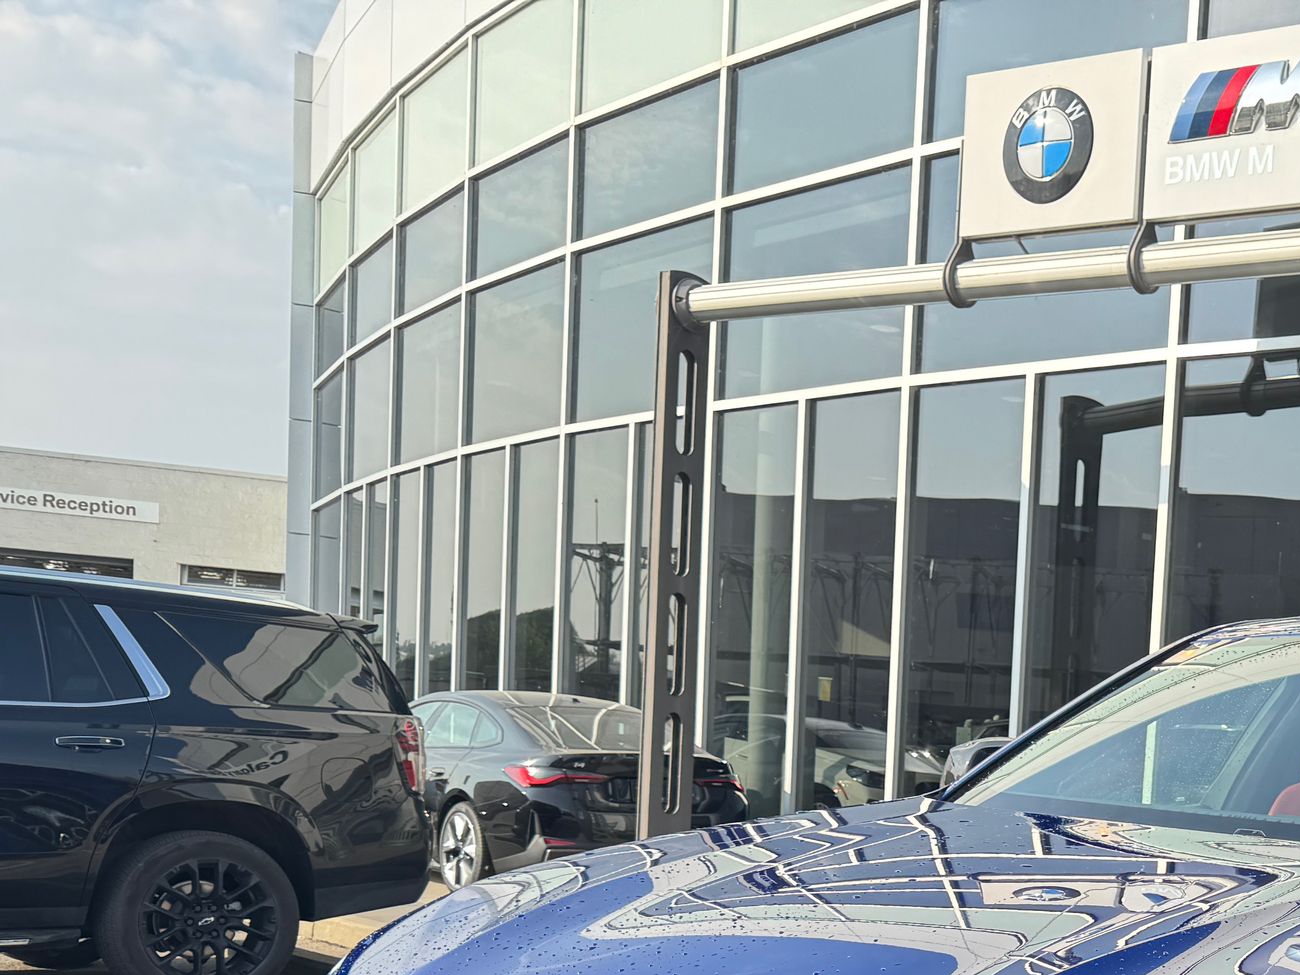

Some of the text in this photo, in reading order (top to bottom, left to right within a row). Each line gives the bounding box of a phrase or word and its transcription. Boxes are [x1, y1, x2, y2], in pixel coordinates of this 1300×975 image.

[1012, 89, 1085, 128] BMW
[1165, 144, 1274, 185] BMW M
[43, 493, 137, 516] Reception
